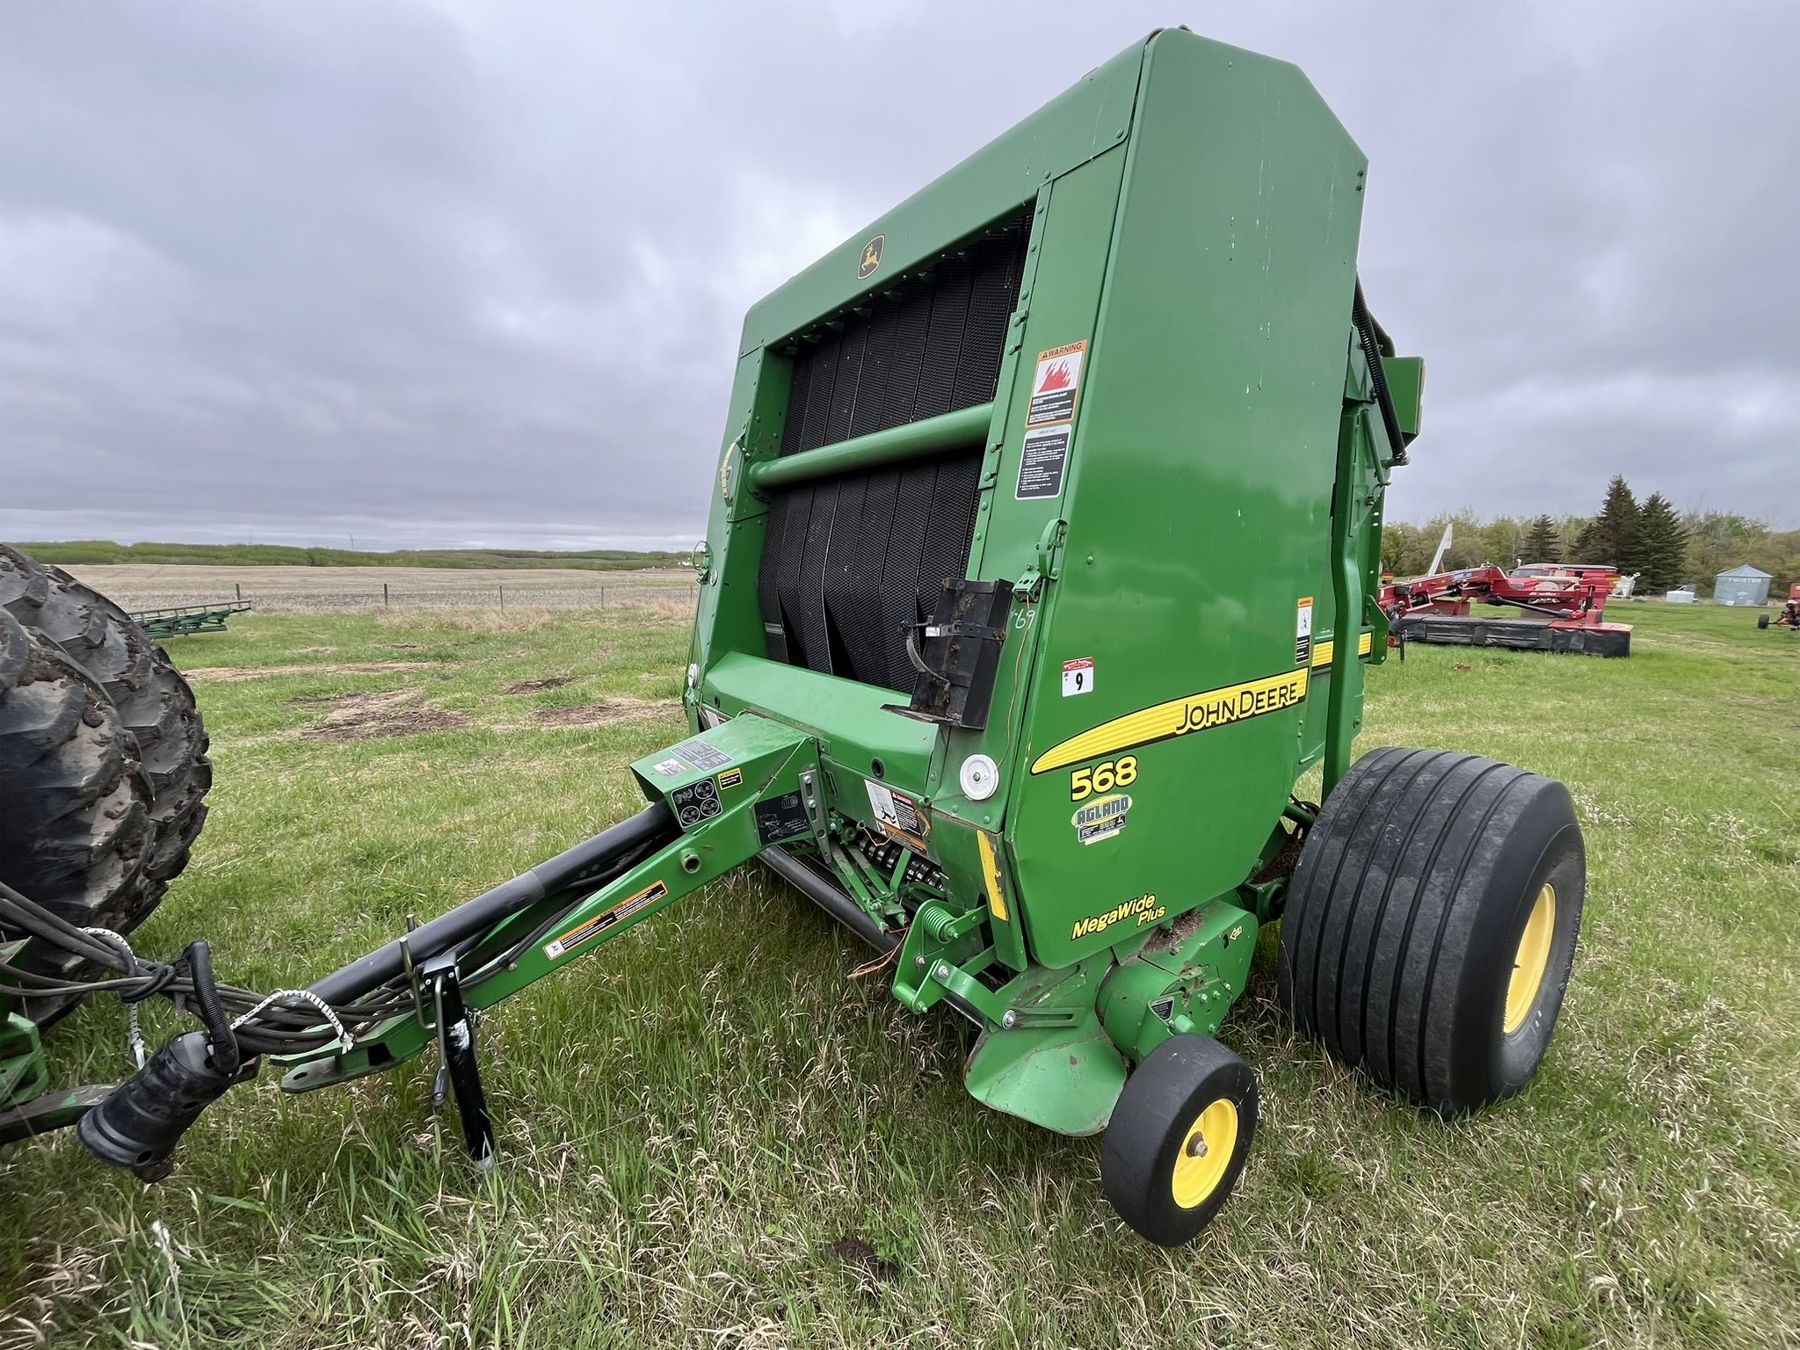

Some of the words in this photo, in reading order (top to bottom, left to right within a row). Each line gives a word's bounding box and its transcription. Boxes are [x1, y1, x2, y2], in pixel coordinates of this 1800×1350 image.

[1048, 342, 1082, 357] WARNING
[1075, 672, 1083, 691] 9
[1176, 698, 1235, 731] JOHN
[1240, 682, 1298, 714] DEERE
[1071, 755, 1138, 802] 568
[1077, 796, 1129, 825] AGLAND
[1071, 893, 1156, 940] MegaWide
[1137, 904, 1167, 927] Plus
